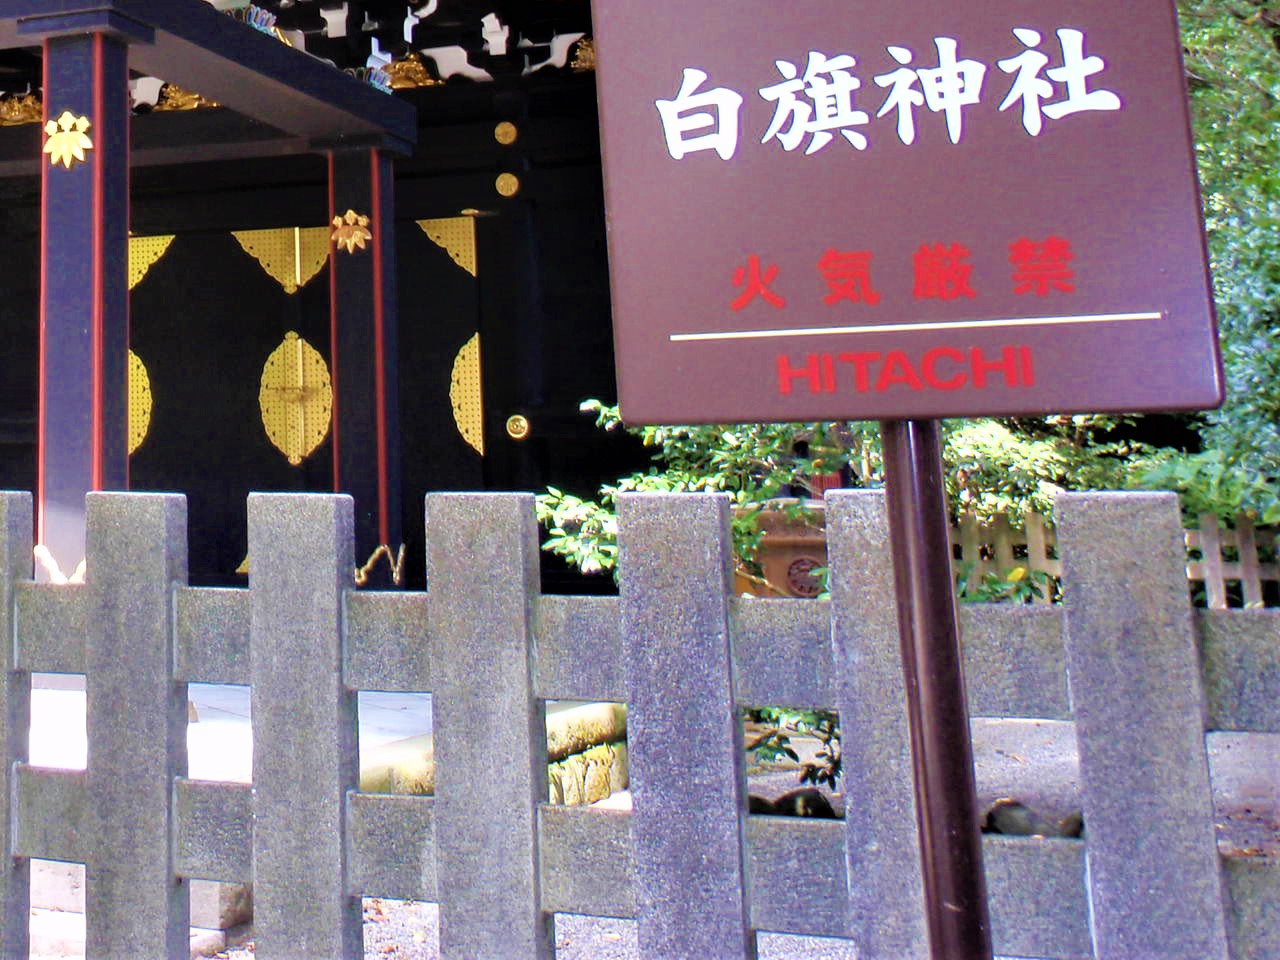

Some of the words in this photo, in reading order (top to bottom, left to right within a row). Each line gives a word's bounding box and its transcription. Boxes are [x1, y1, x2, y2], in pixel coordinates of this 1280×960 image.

[655, 27, 1121, 161] 白旗神社
[730, 235, 1075, 312] 火気厳禁
[776, 345, 1035, 396] HITACHI
